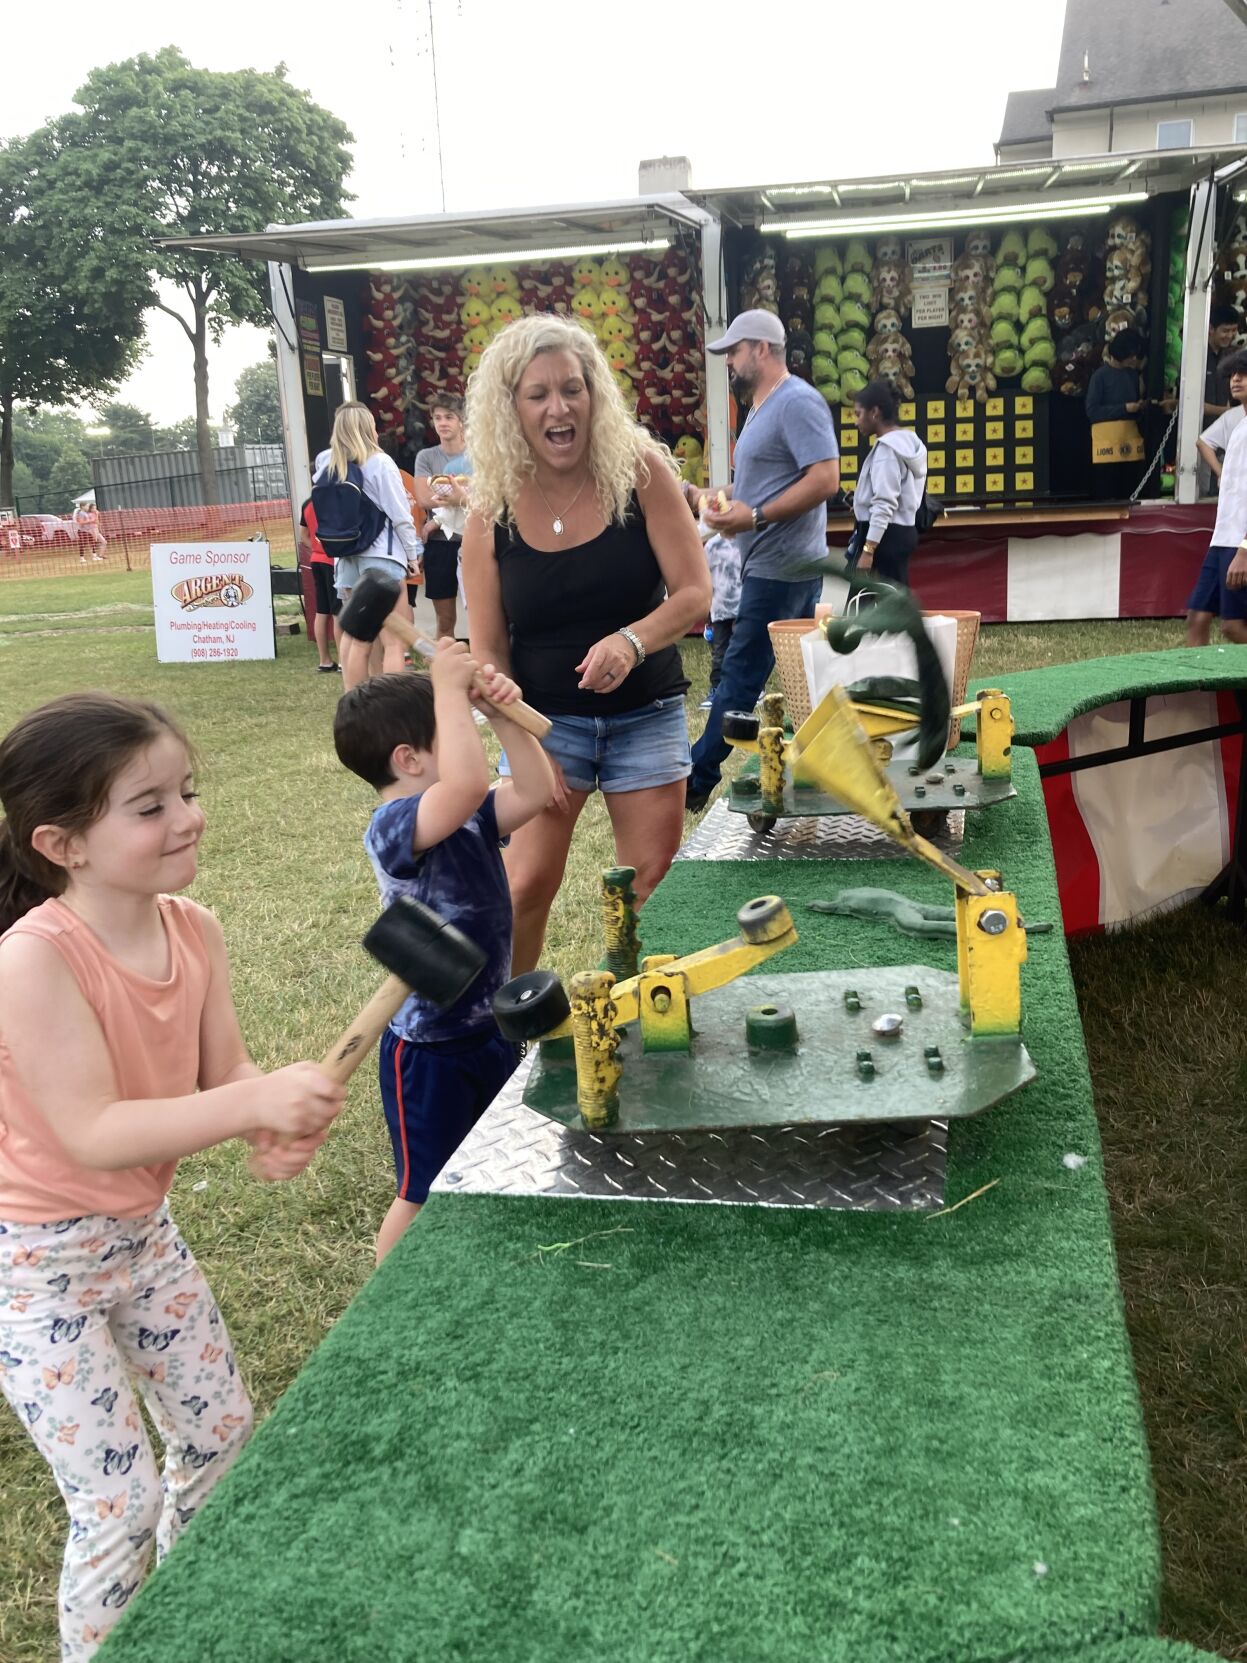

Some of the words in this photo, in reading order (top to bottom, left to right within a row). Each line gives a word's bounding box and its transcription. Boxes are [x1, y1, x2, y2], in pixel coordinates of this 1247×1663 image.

[1096, 447, 1114, 456] LIONS
[170, 551, 202, 565] Game
[205, 550, 250, 567] Sponsor
[181, 573, 245, 607] ARGENT
[169, 620, 257, 632] Plumbing/Heating/Cooling
[192, 634, 225, 645] Chatham,
[226, 635, 235, 643] NJ
[191, 648, 208, 659] (908)
[209, 647, 239, 657] 286-1920
